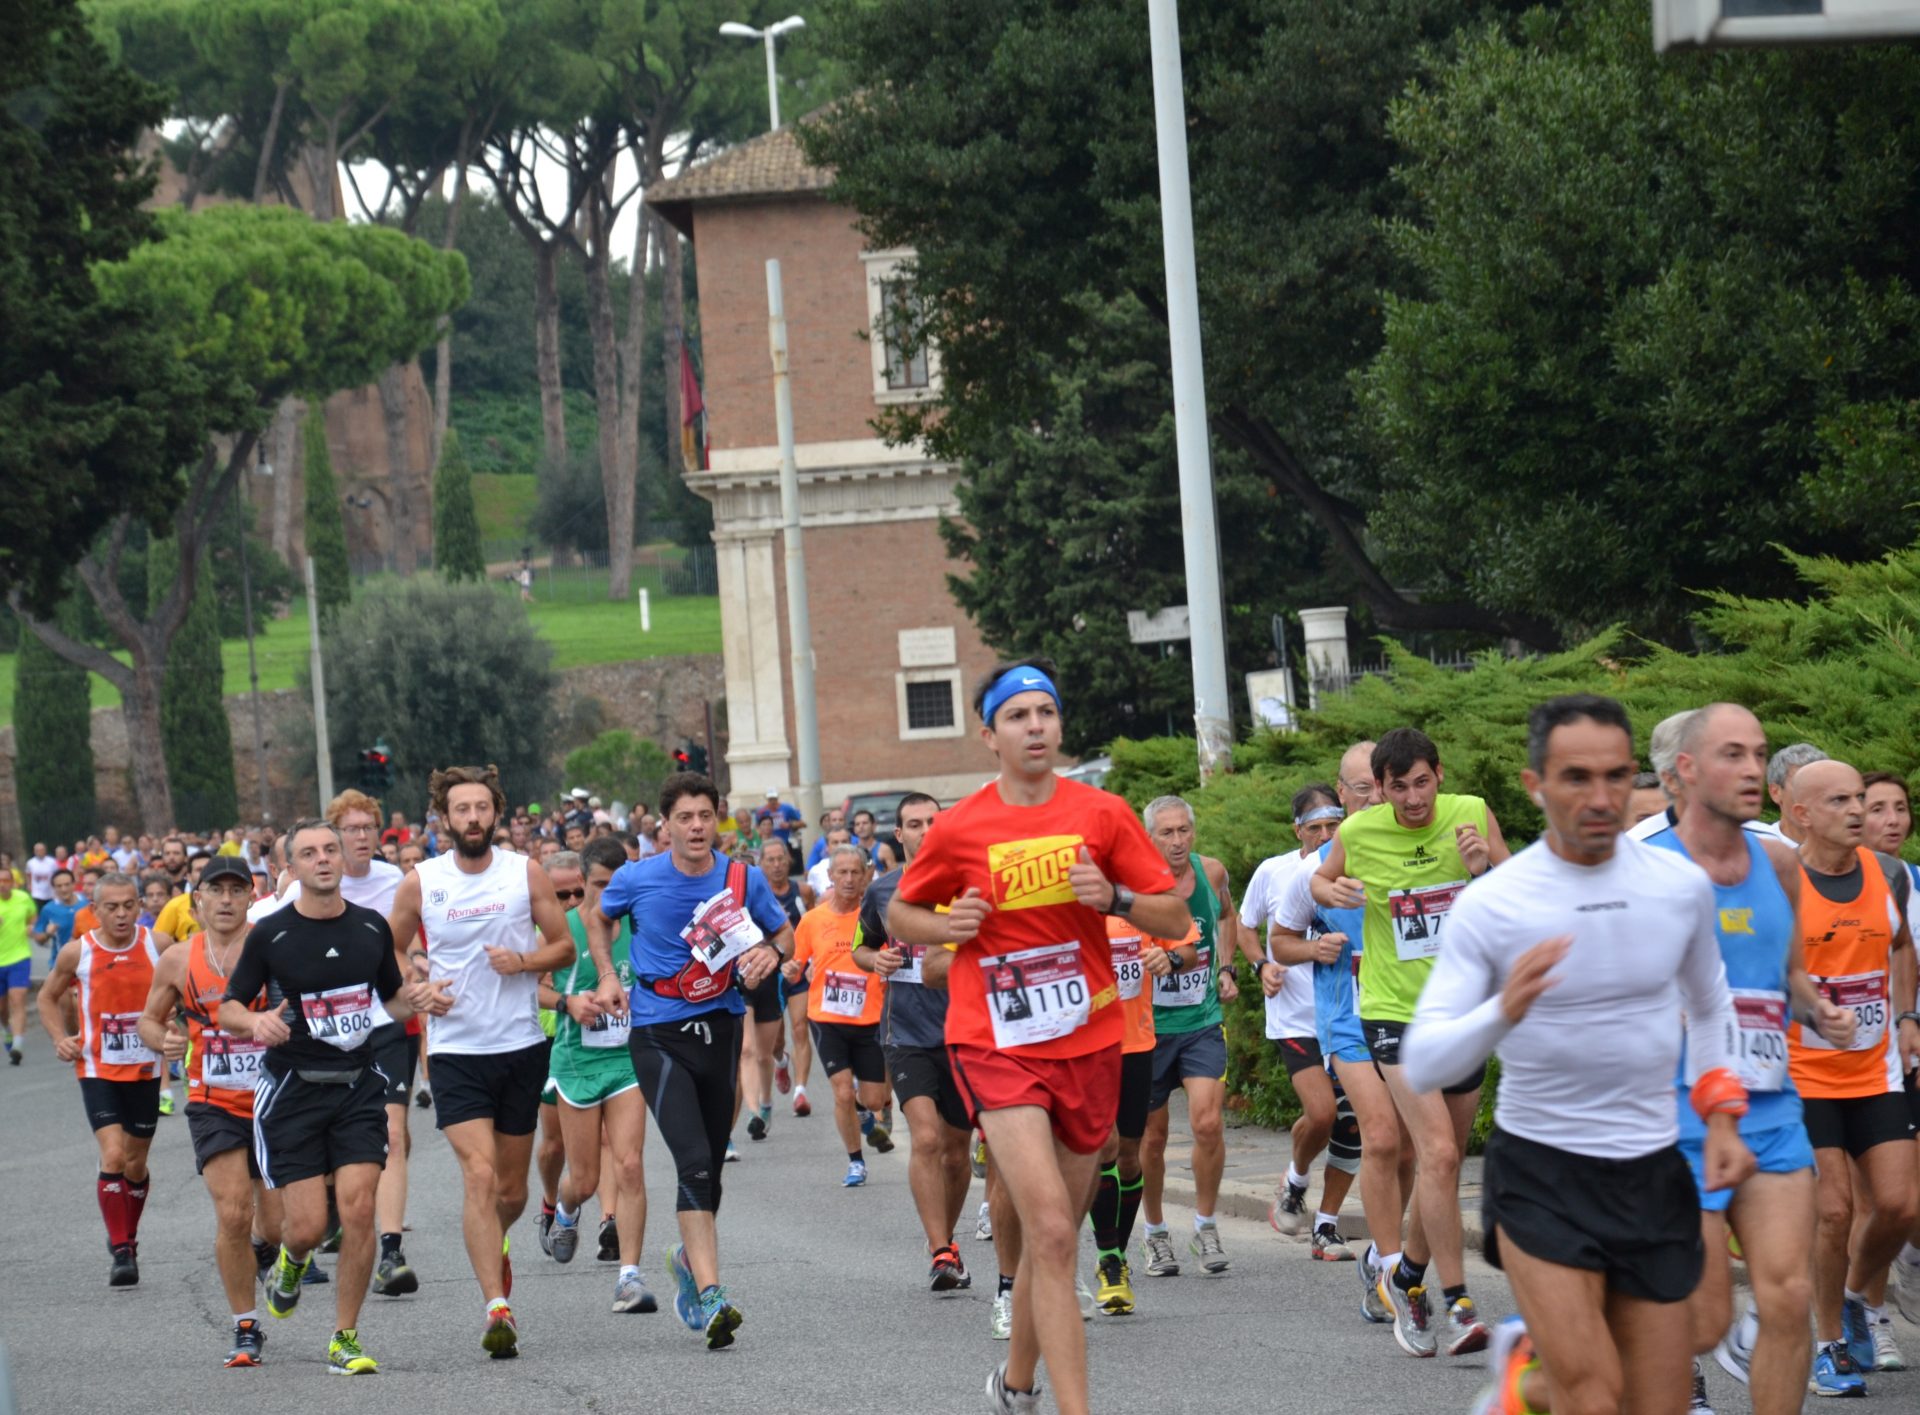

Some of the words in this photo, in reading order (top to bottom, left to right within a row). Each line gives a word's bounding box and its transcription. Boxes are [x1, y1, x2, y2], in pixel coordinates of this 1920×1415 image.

[1001, 847, 1077, 901] 2009
[840, 990, 864, 1005] 815
[1035, 980, 1083, 1012] 110
[340, 1010, 371, 1034] 806
